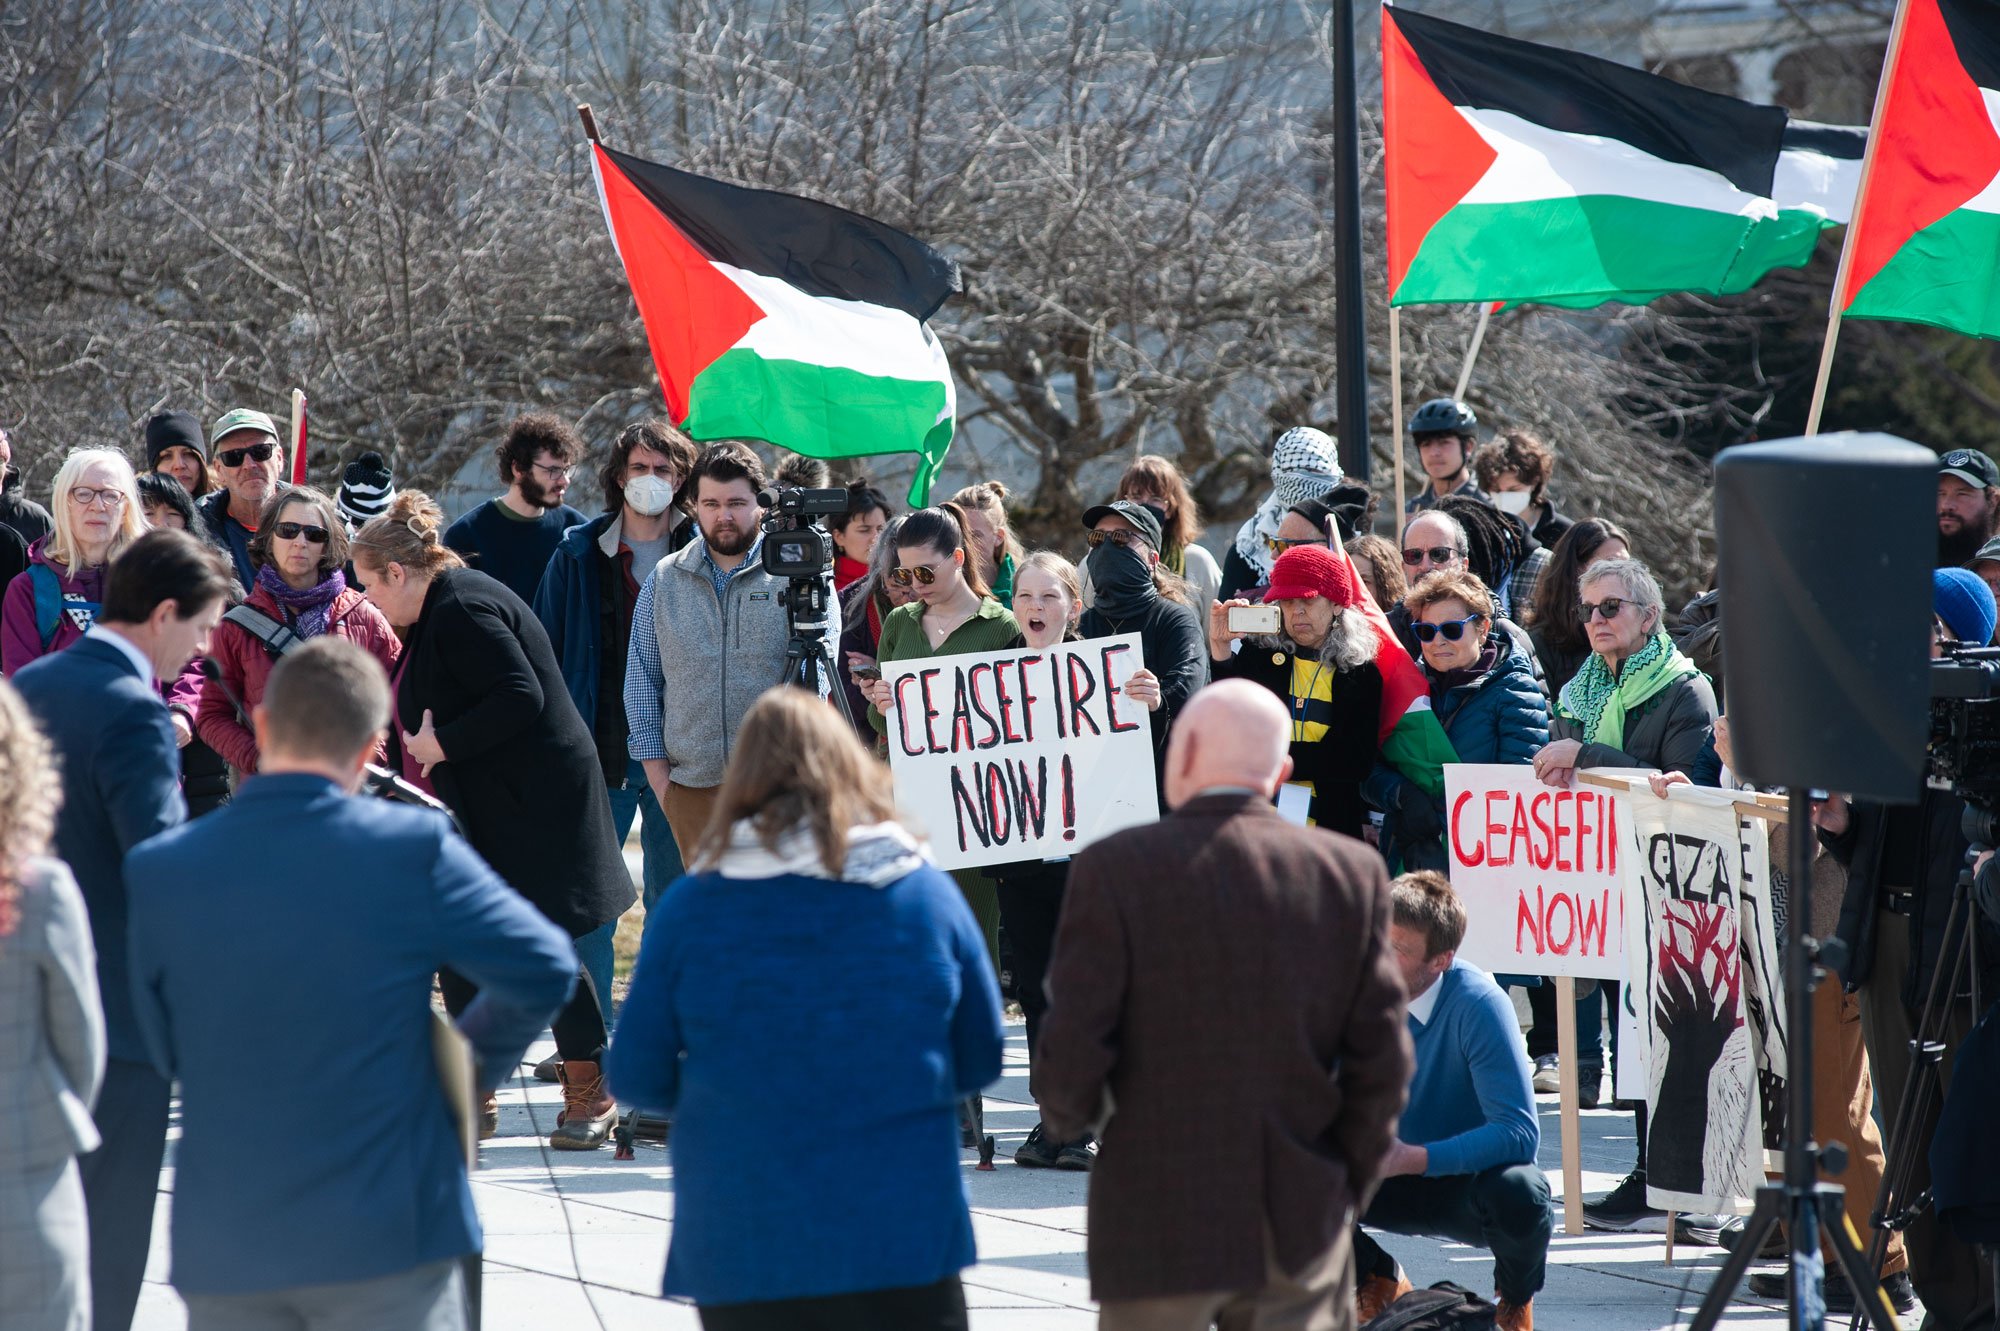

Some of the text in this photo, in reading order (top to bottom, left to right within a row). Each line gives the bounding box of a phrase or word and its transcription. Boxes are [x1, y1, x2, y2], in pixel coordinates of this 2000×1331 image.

[894, 644, 1140, 756] CEASEFIRE
[951, 753, 1076, 852] NOW!
[1516, 884, 1623, 957] NOW
